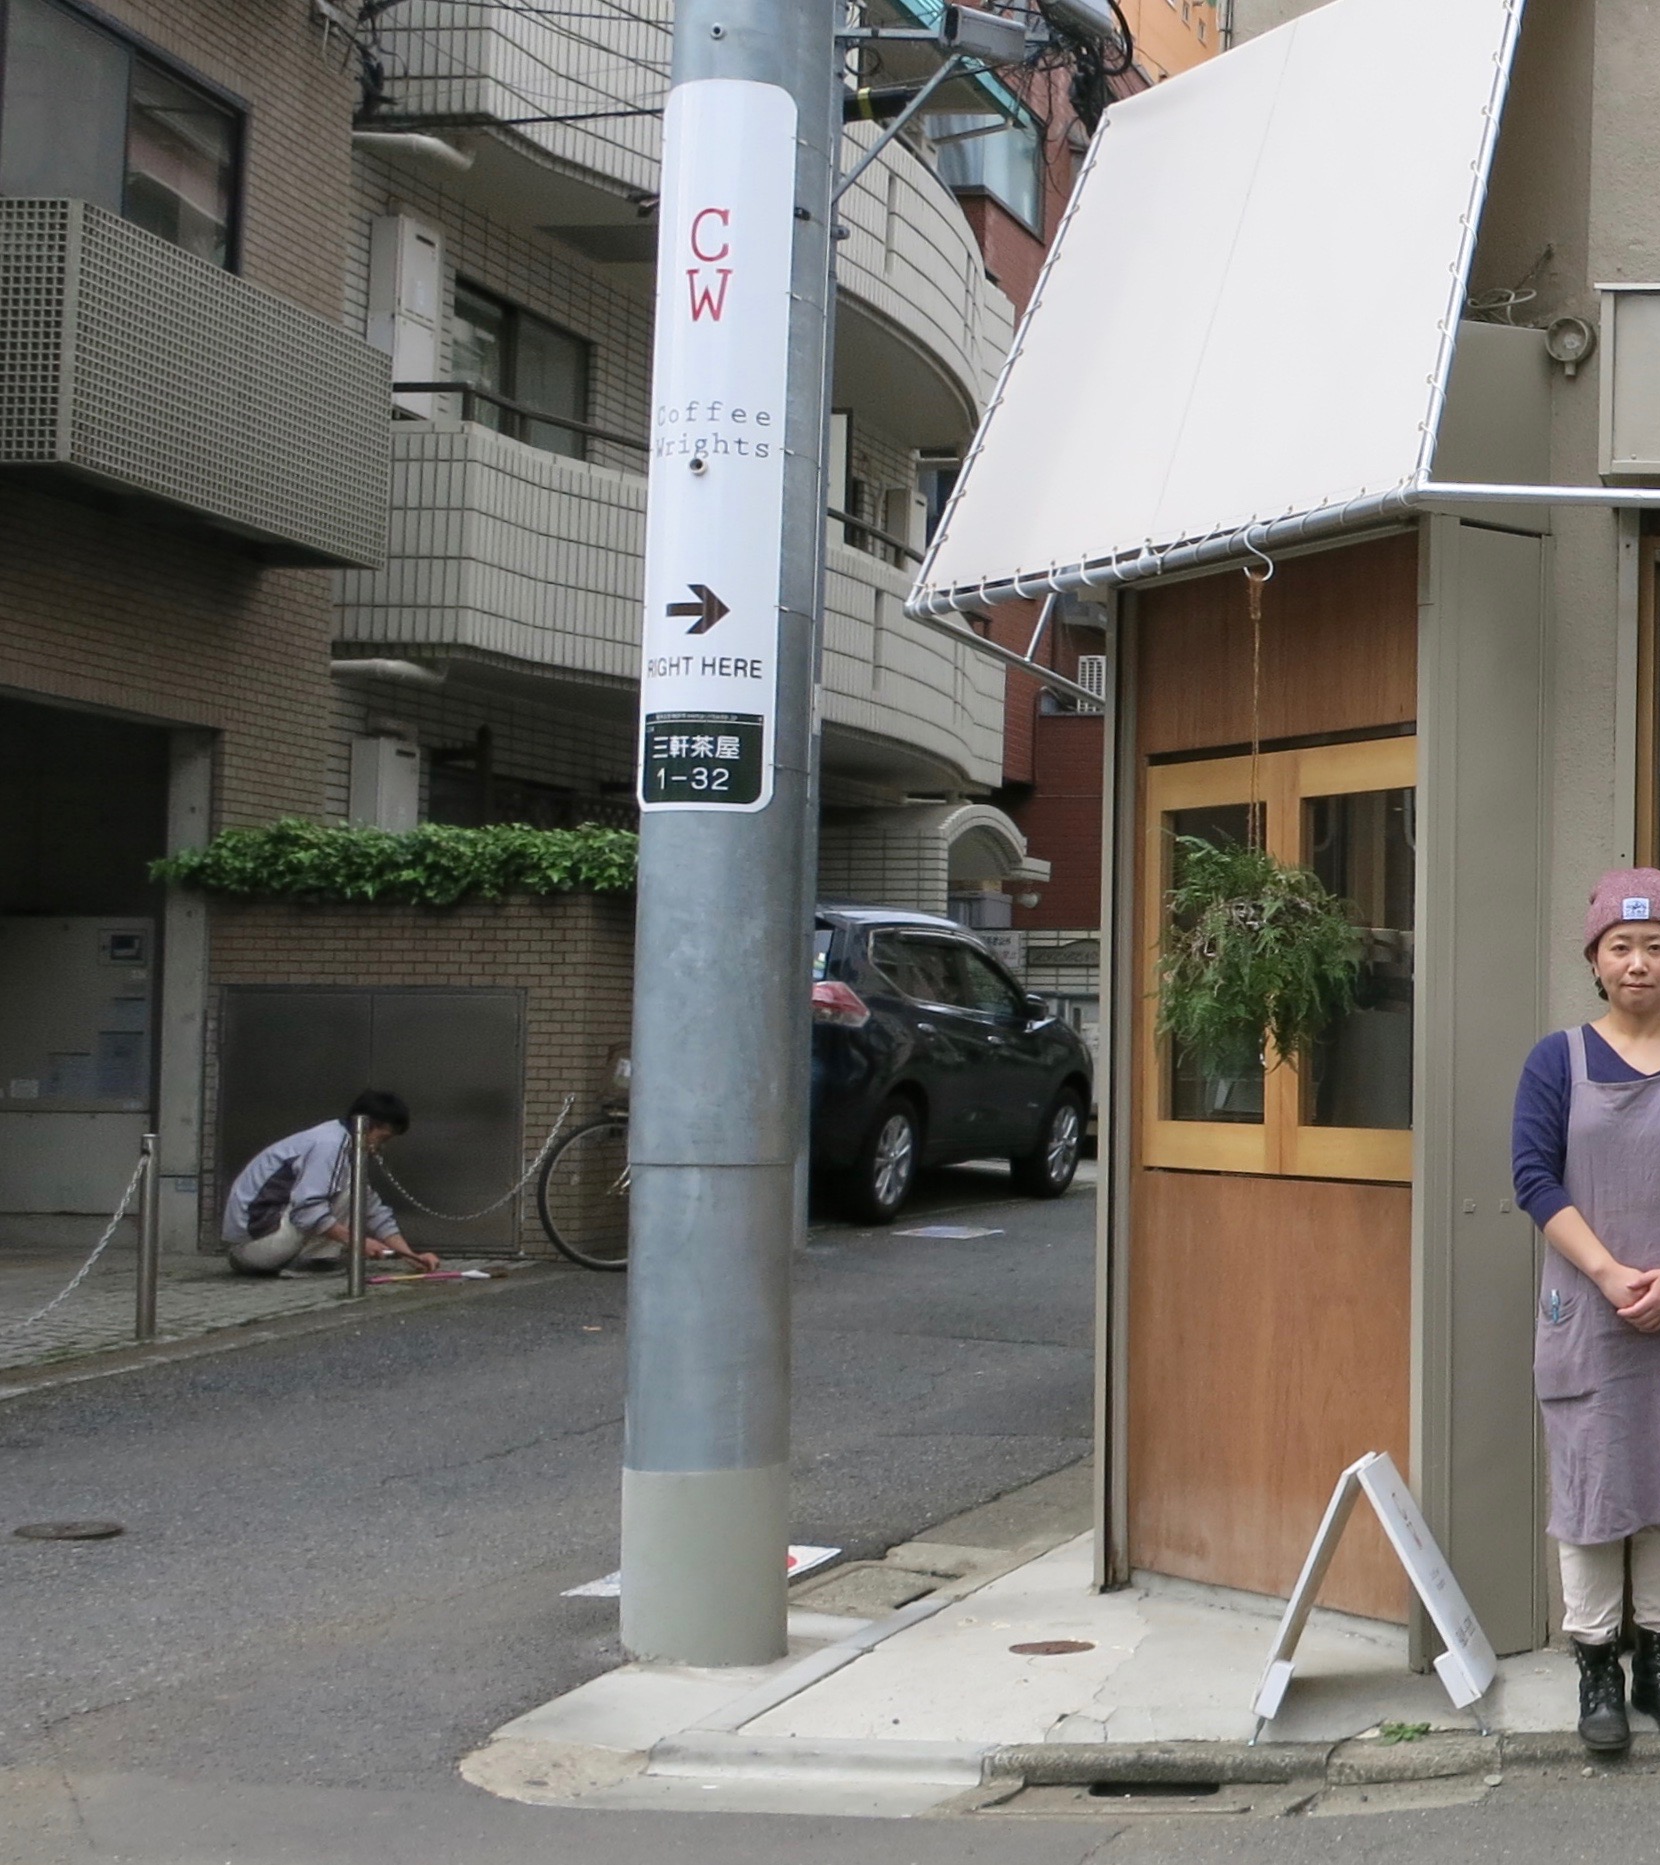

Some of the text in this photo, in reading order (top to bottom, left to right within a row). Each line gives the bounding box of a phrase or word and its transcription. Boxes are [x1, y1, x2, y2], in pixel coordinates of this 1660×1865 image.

[656, 401, 772, 427] Coffee
[655, 433, 770, 459] Wrights
[647, 656, 763, 679] RIGHT HERE
[652, 734, 741, 759] 三軒茶屋
[656, 766, 730, 791] 1-32
